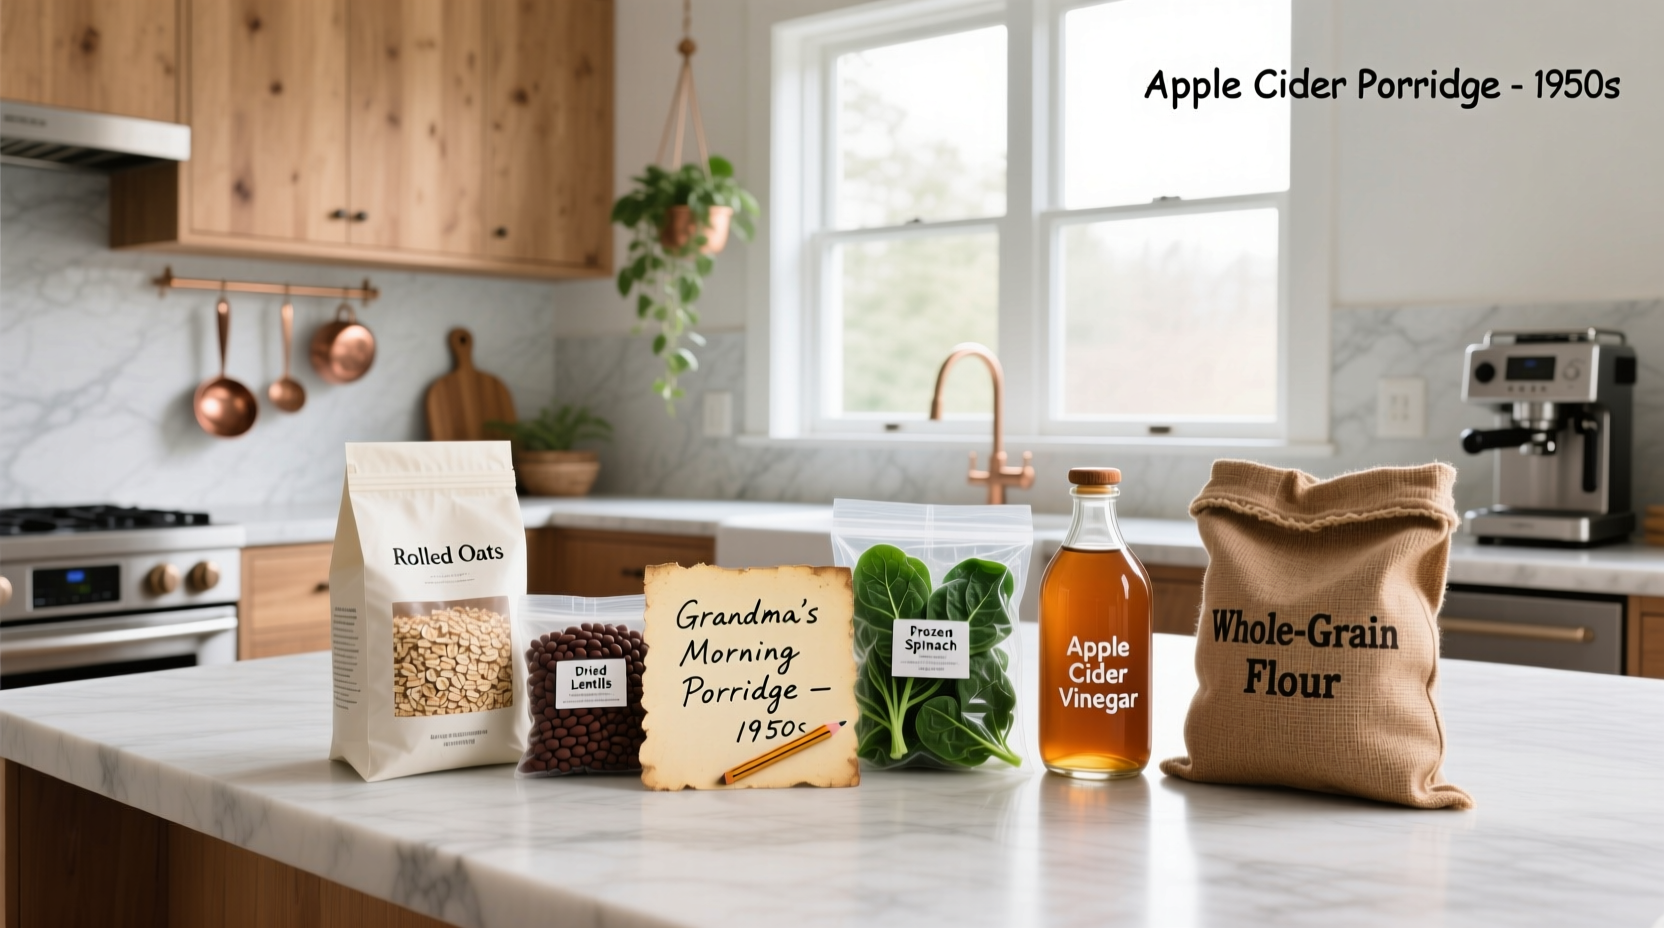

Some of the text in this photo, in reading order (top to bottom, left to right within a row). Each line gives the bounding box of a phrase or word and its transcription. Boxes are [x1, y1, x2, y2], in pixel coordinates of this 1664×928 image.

[392, 543, 504, 566] Rolled Oats
[1212, 609, 1399, 649] Whole-Grain
[679, 638, 800, 675] Morning
[1066, 635, 1130, 662] Apple
[575, 664, 607, 677] Dried
[1068, 662, 1128, 684] Cider
[1243, 658, 1342, 699] Flour
[682, 674, 798, 714] Porridge
[1058, 687, 1139, 715] Vinegar
